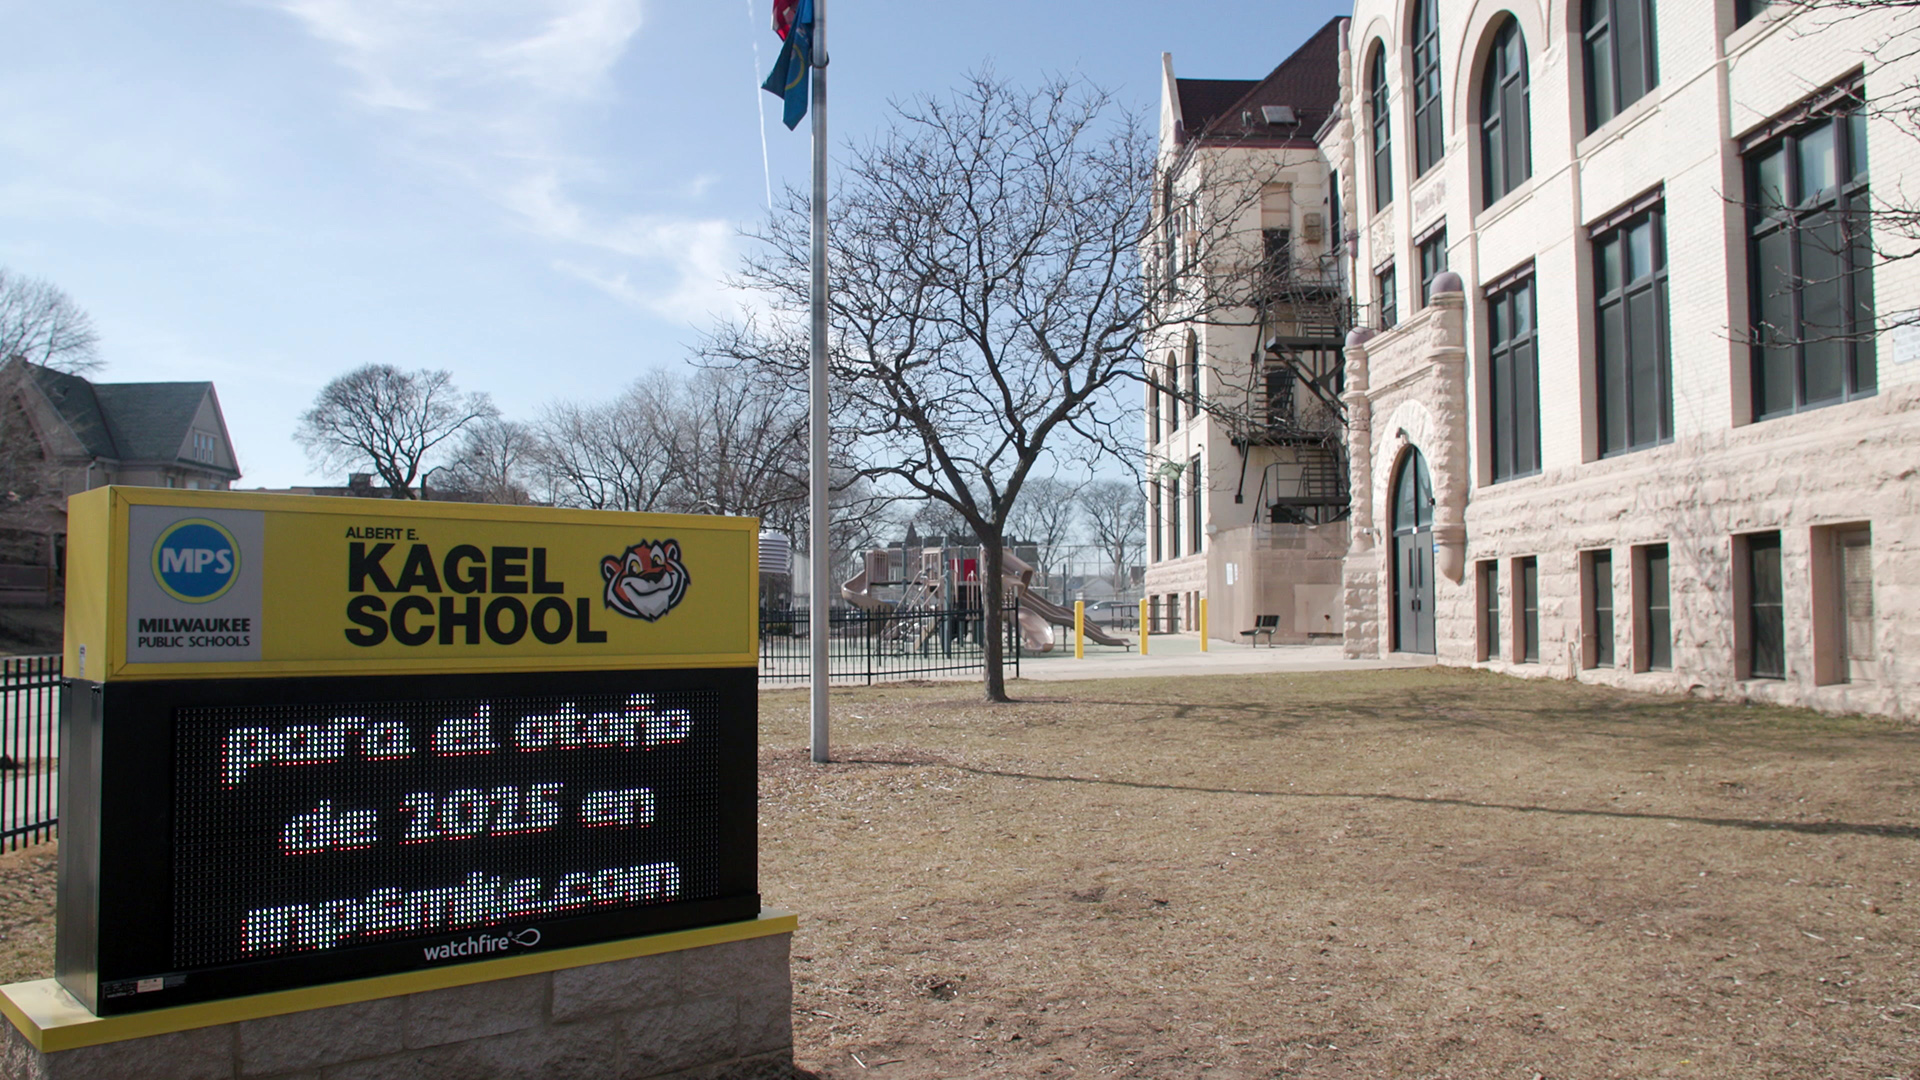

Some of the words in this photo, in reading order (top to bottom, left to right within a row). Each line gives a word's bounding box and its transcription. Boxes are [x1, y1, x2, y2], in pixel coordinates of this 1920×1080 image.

[346, 527, 403, 540] ALBERT
[407, 529, 419, 541] E.
[162, 548, 232, 574] MPS
[349, 542, 564, 594] KAGEL
[138, 618, 250, 632] MILWAUKEE
[345, 595, 607, 646] SCHOOL
[138, 636, 184, 648] PUBLIC
[188, 635, 250, 647] SCHOOLS
[221, 716, 415, 790] para
[279, 799, 376, 856] de
[579, 787, 655, 829] en
[424, 935, 508, 960] watchfire
